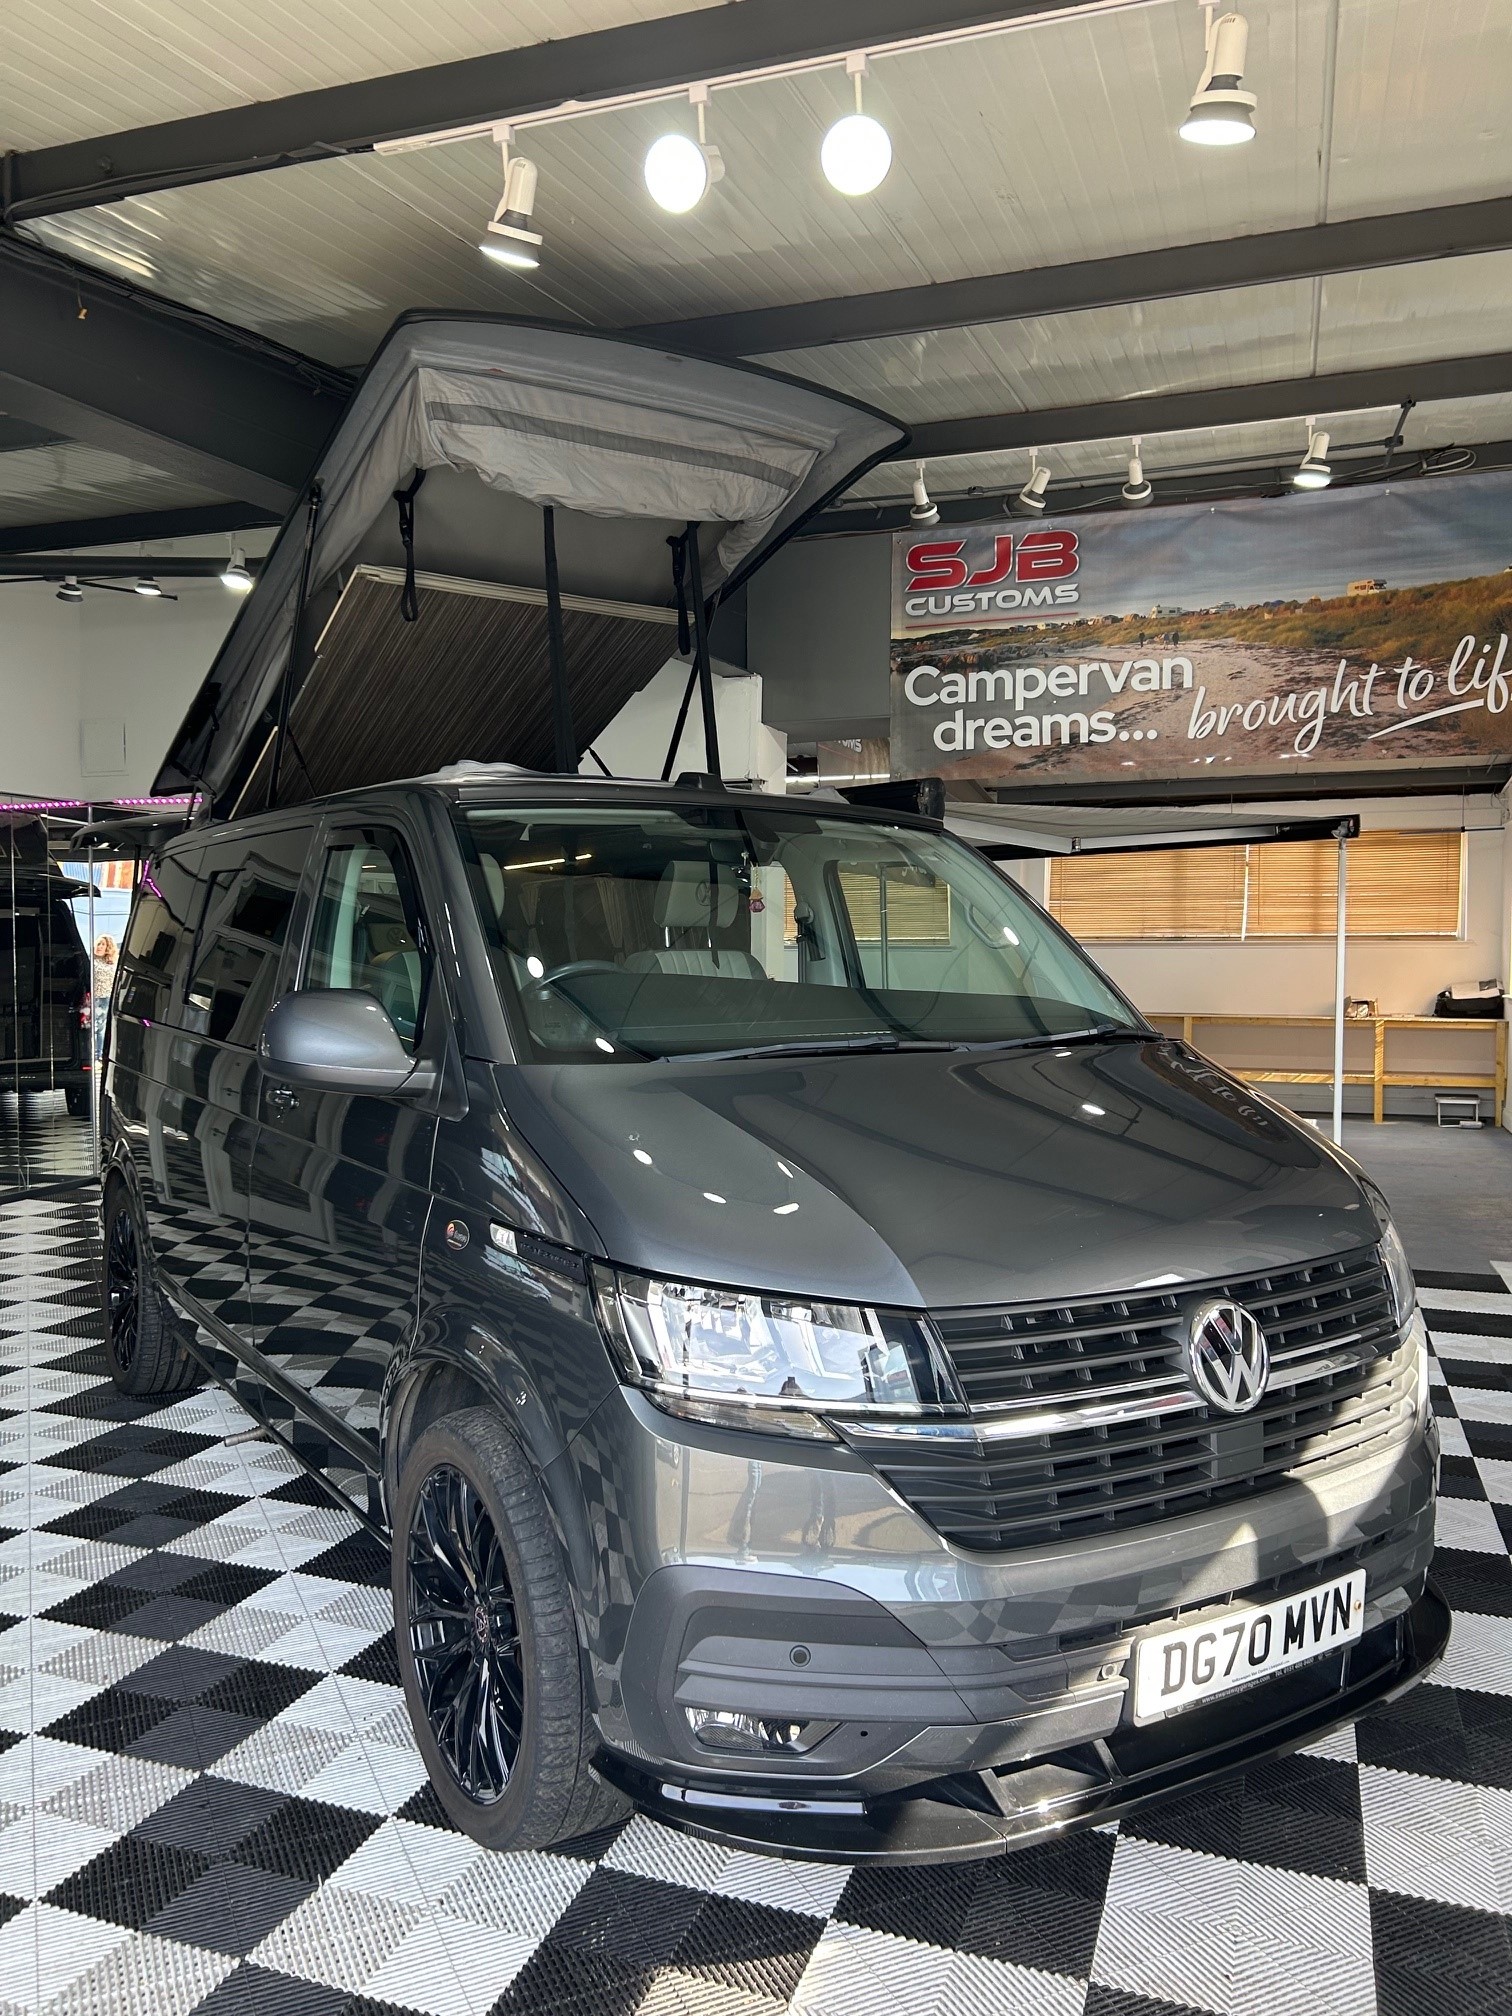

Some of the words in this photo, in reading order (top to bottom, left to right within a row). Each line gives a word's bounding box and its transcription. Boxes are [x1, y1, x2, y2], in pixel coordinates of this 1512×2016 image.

[905, 530, 1079, 592] SJB
[905, 583, 1079, 616] CUSTOMS
[904, 656, 1193, 711] Campervan
[1188, 659, 1386, 753] brought
[1393, 656, 1435, 709] to
[1448, 633, 1512, 714] lif
[933, 709, 1158, 751] dreams...
[1161, 1613, 1272, 1697] DG70
[1283, 1581, 1353, 1656] MVN
